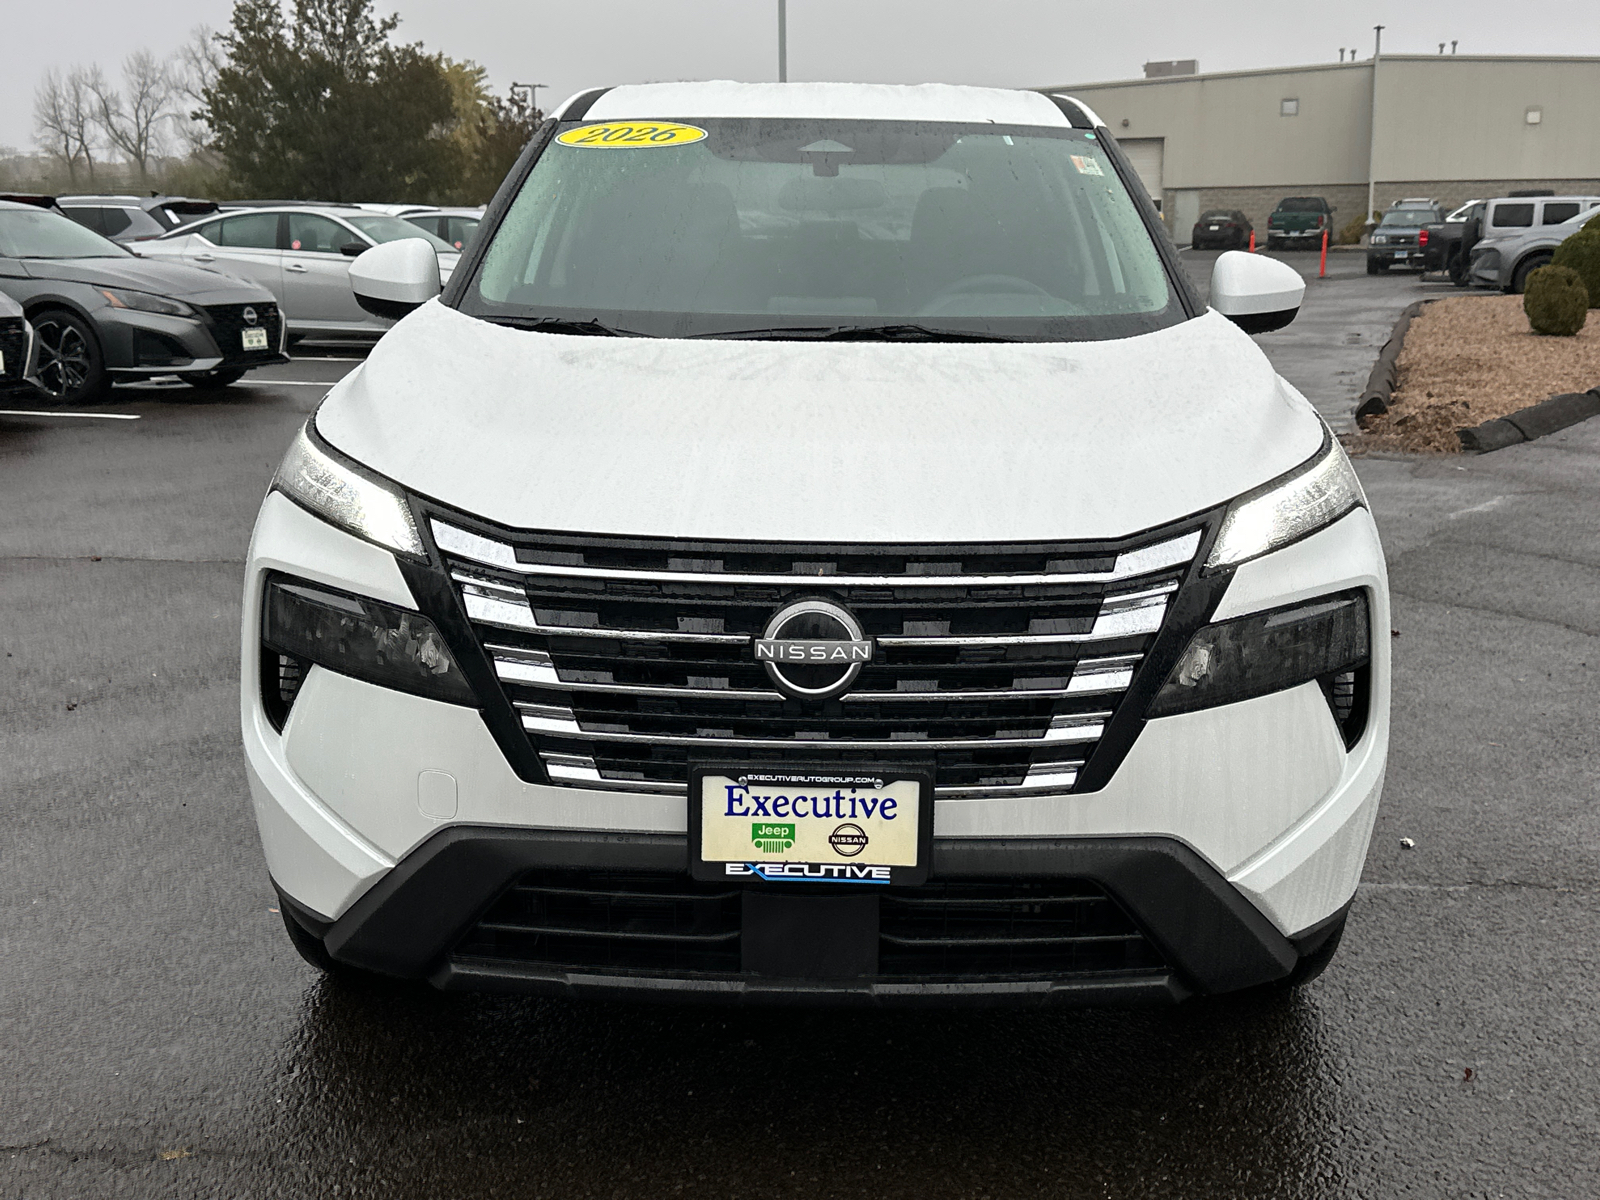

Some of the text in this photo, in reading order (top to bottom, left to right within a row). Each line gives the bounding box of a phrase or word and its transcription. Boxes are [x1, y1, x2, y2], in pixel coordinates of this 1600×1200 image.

[574, 127, 687, 143] 2026
[757, 643, 869, 660] NISSAN
[747, 774, 875, 783] EXECUTIVEAUTOGROUP.COM
[724, 785, 898, 821] Executive
[758, 825, 789, 838] Jeep
[831, 836, 866, 844] NISSAN
[726, 863, 891, 879] EXECUTIVE
